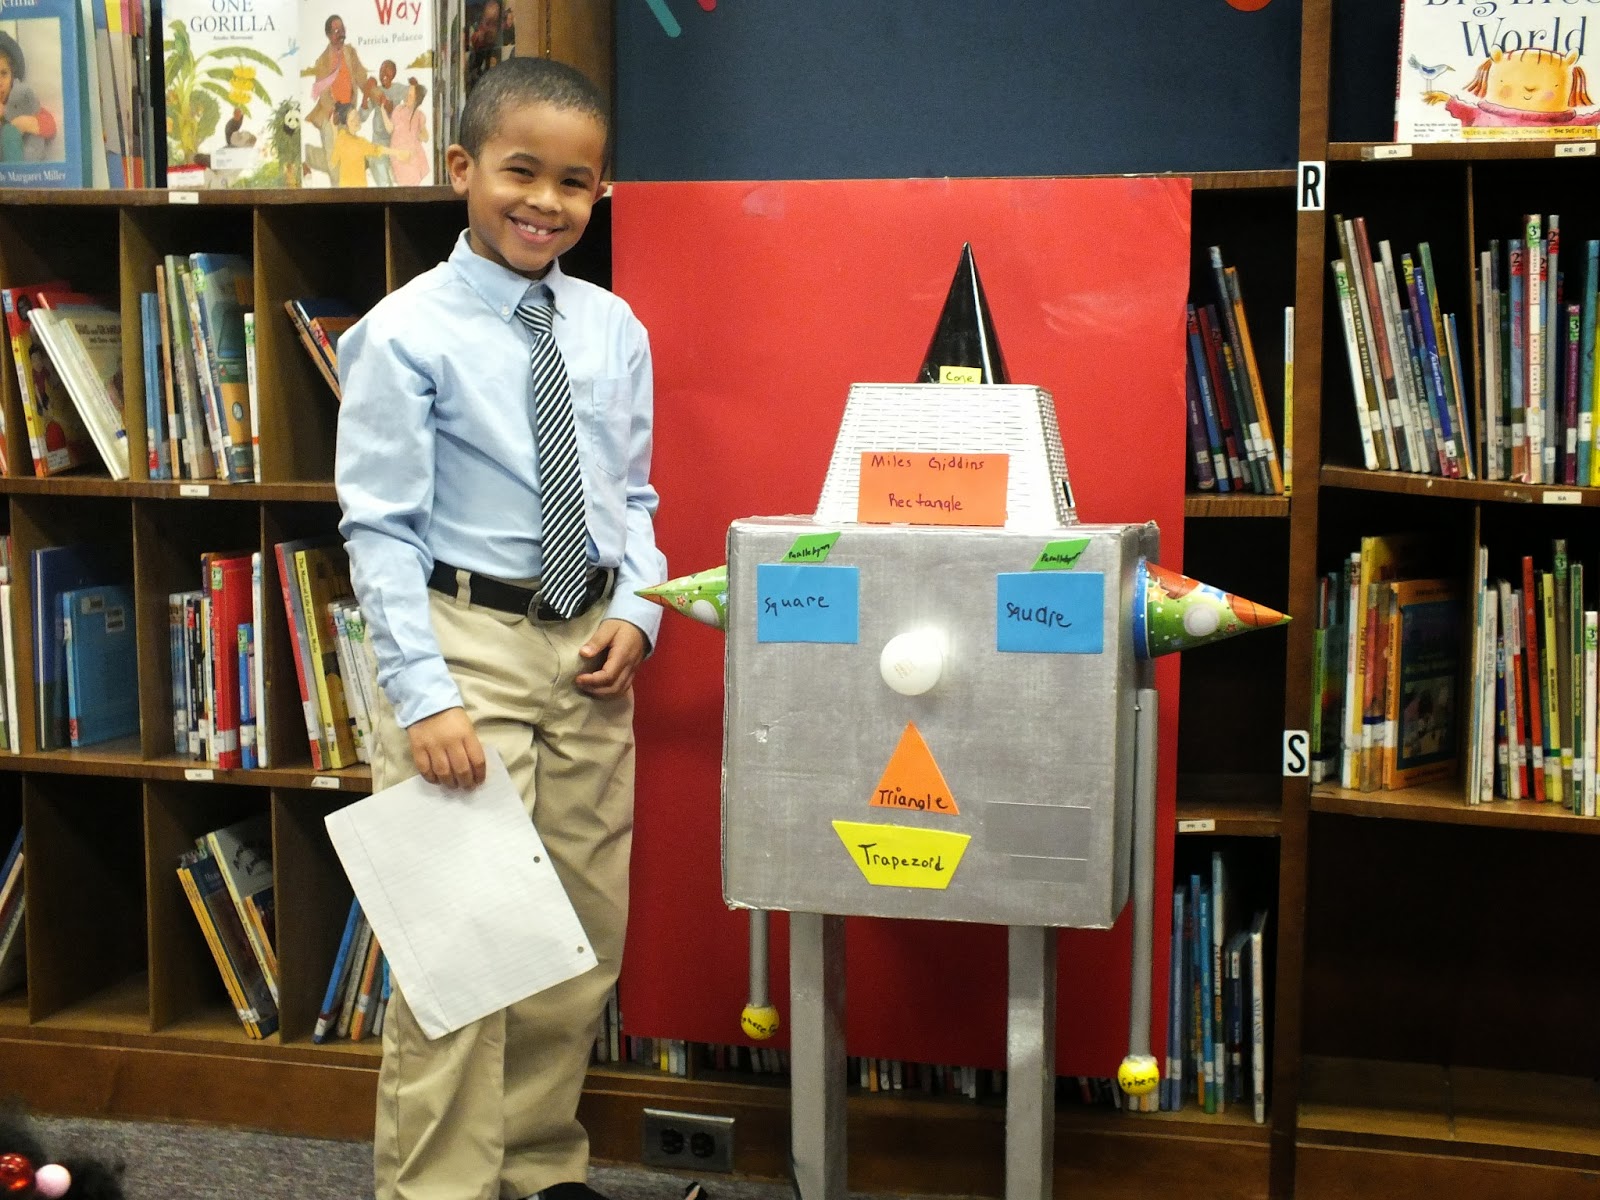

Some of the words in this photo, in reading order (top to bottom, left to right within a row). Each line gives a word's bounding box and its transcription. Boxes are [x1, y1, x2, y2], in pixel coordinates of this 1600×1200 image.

[212, 0, 254, 13] ONE
[374, 0, 422, 26] Way
[190, 15, 276, 33] GORILLA
[1461, 16, 1587, 58] World
[1302, 165, 1322, 208] R
[945, 371, 975, 383] Cone
[871, 455, 912, 468] Miles
[928, 457, 985, 470] Giddins
[888, 493, 964, 512] Rectangle
[1288, 735, 1306, 773] S
[878, 787, 949, 810] Triangle
[857, 842, 945, 872] Trapezoid
